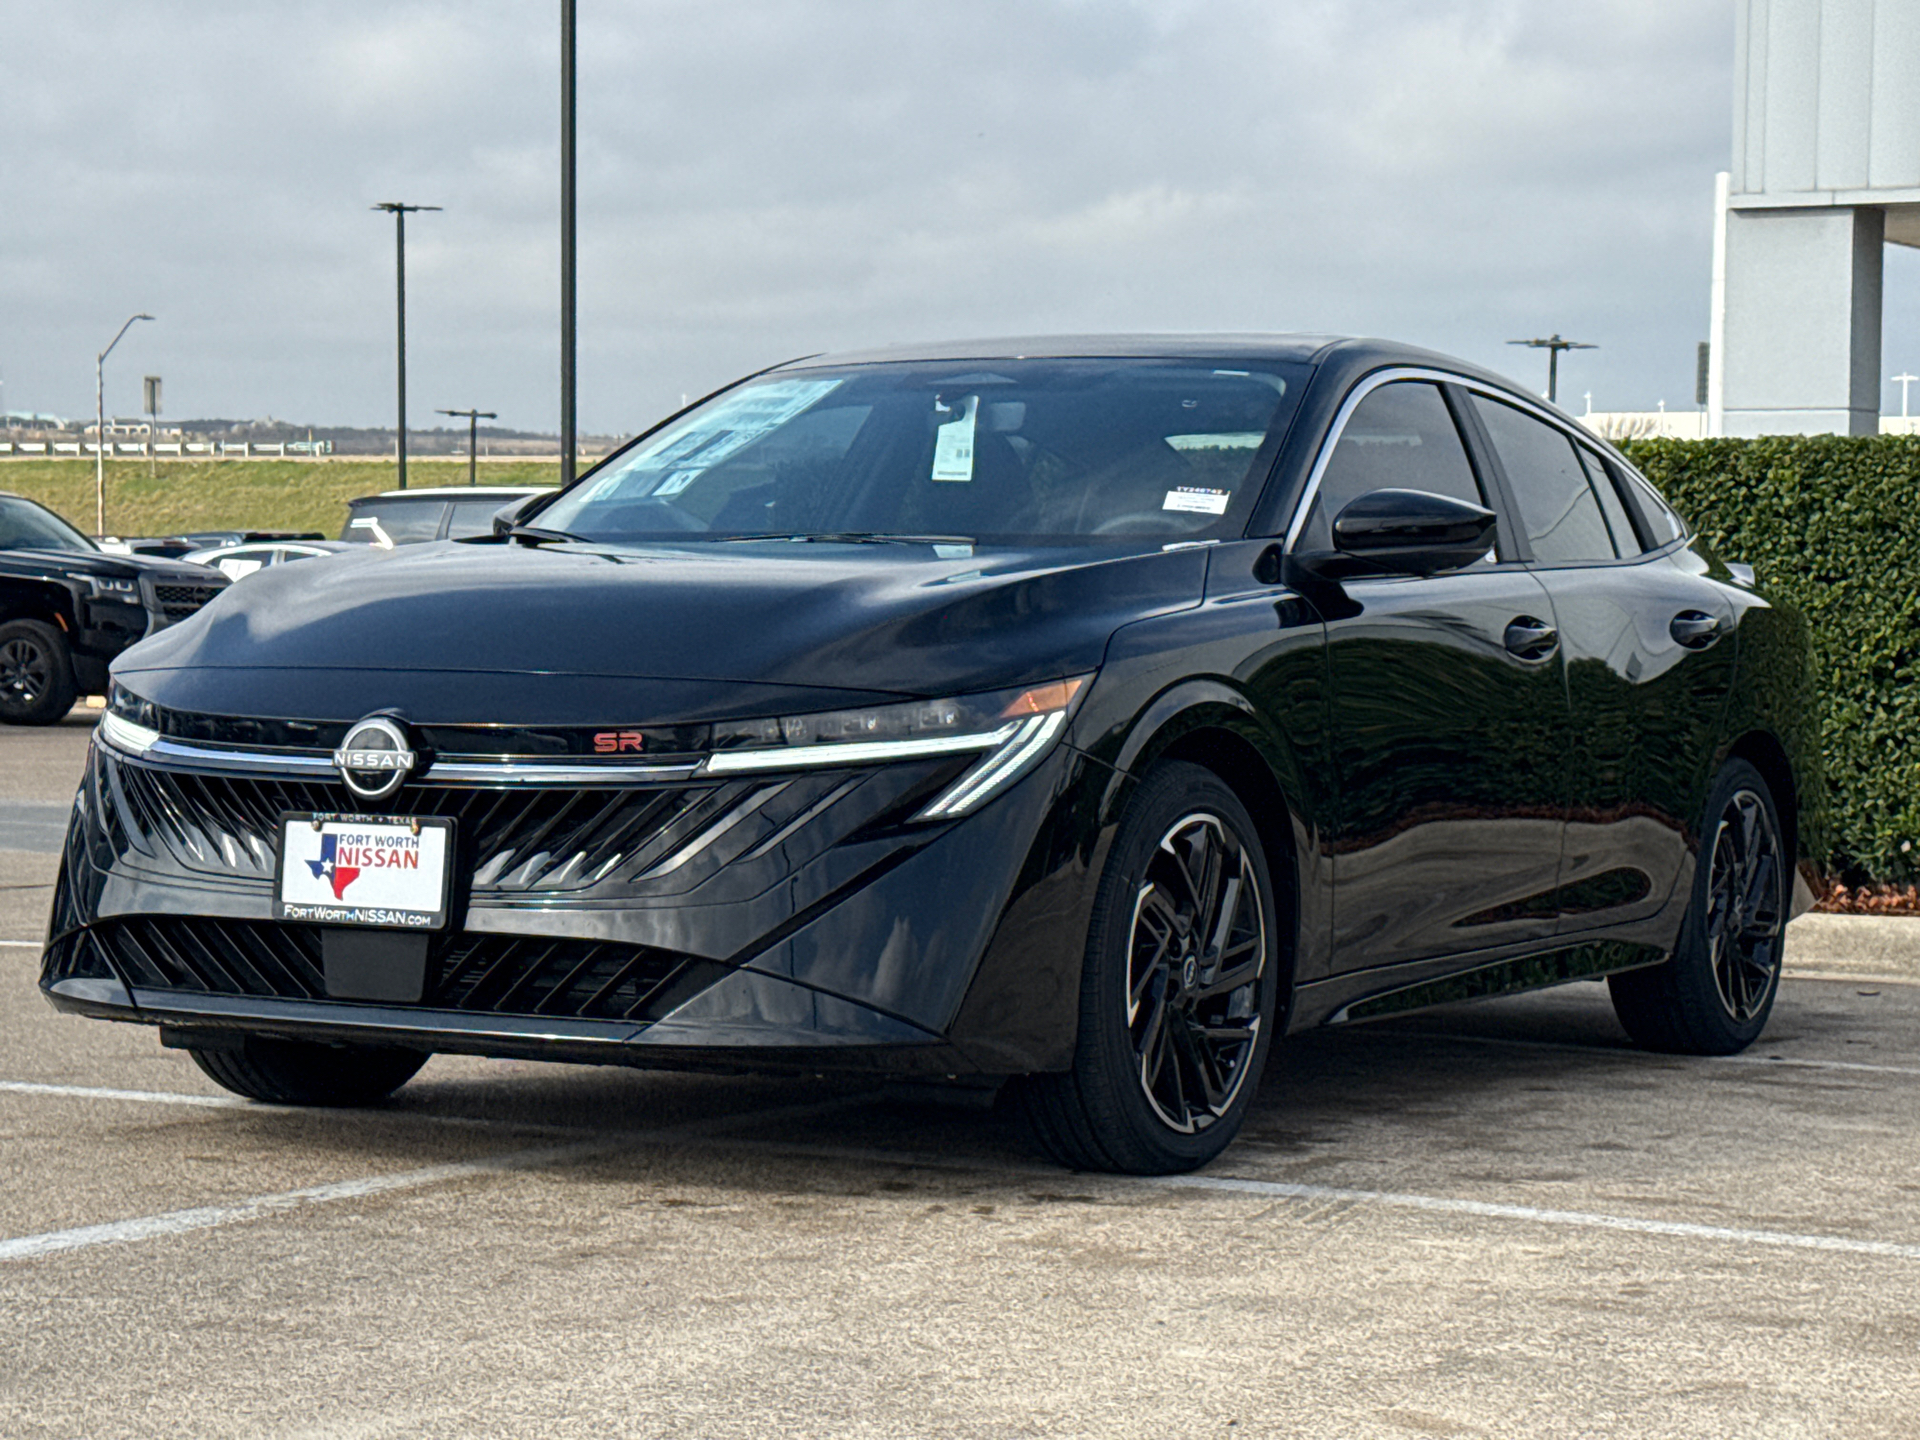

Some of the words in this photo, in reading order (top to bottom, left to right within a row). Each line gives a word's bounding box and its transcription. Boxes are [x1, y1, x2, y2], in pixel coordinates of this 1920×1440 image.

[594, 732, 643, 752] SR
[335, 752, 411, 768] NISSAN
[312, 812, 338, 821] FORT
[340, 813, 374, 823] WORTH
[339, 833, 371, 846] FORT
[375, 835, 419, 849] WORTH
[338, 847, 419, 870] NISSAN
